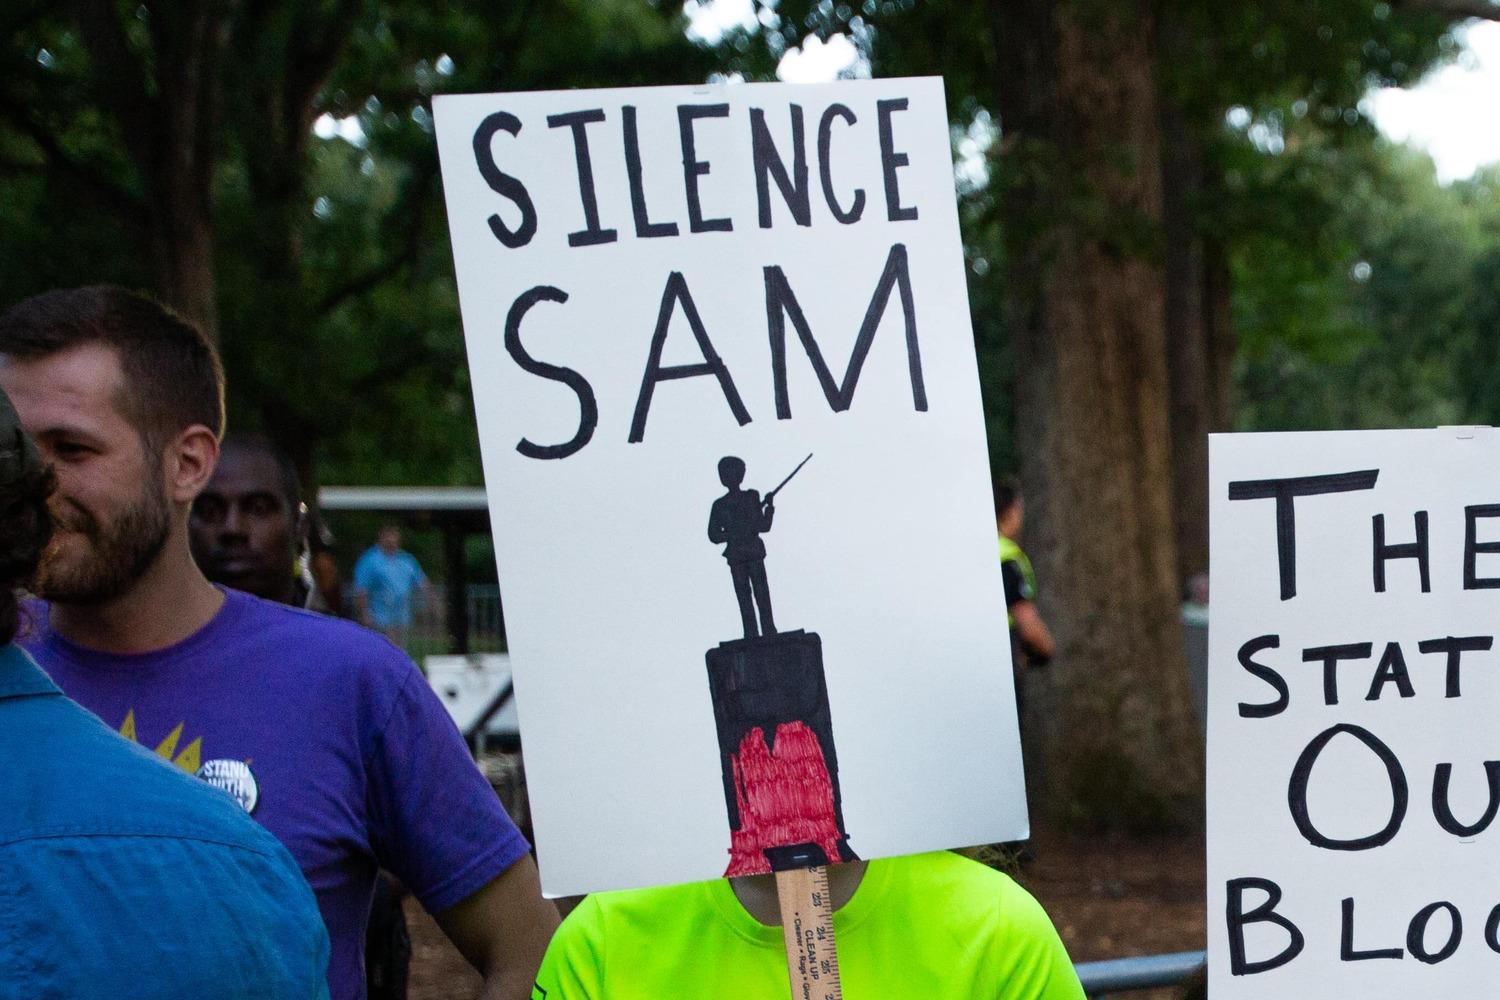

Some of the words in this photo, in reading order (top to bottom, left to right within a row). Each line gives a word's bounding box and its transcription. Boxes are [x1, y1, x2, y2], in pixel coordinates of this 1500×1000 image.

[472, 97, 920, 249] SILENCE
[504, 243, 928, 461] SAM
[816, 926, 826, 941] 24
[805, 929, 817, 966] CLEAN
[810, 966, 819, 980] UP
[820, 960, 830, 975] 25
